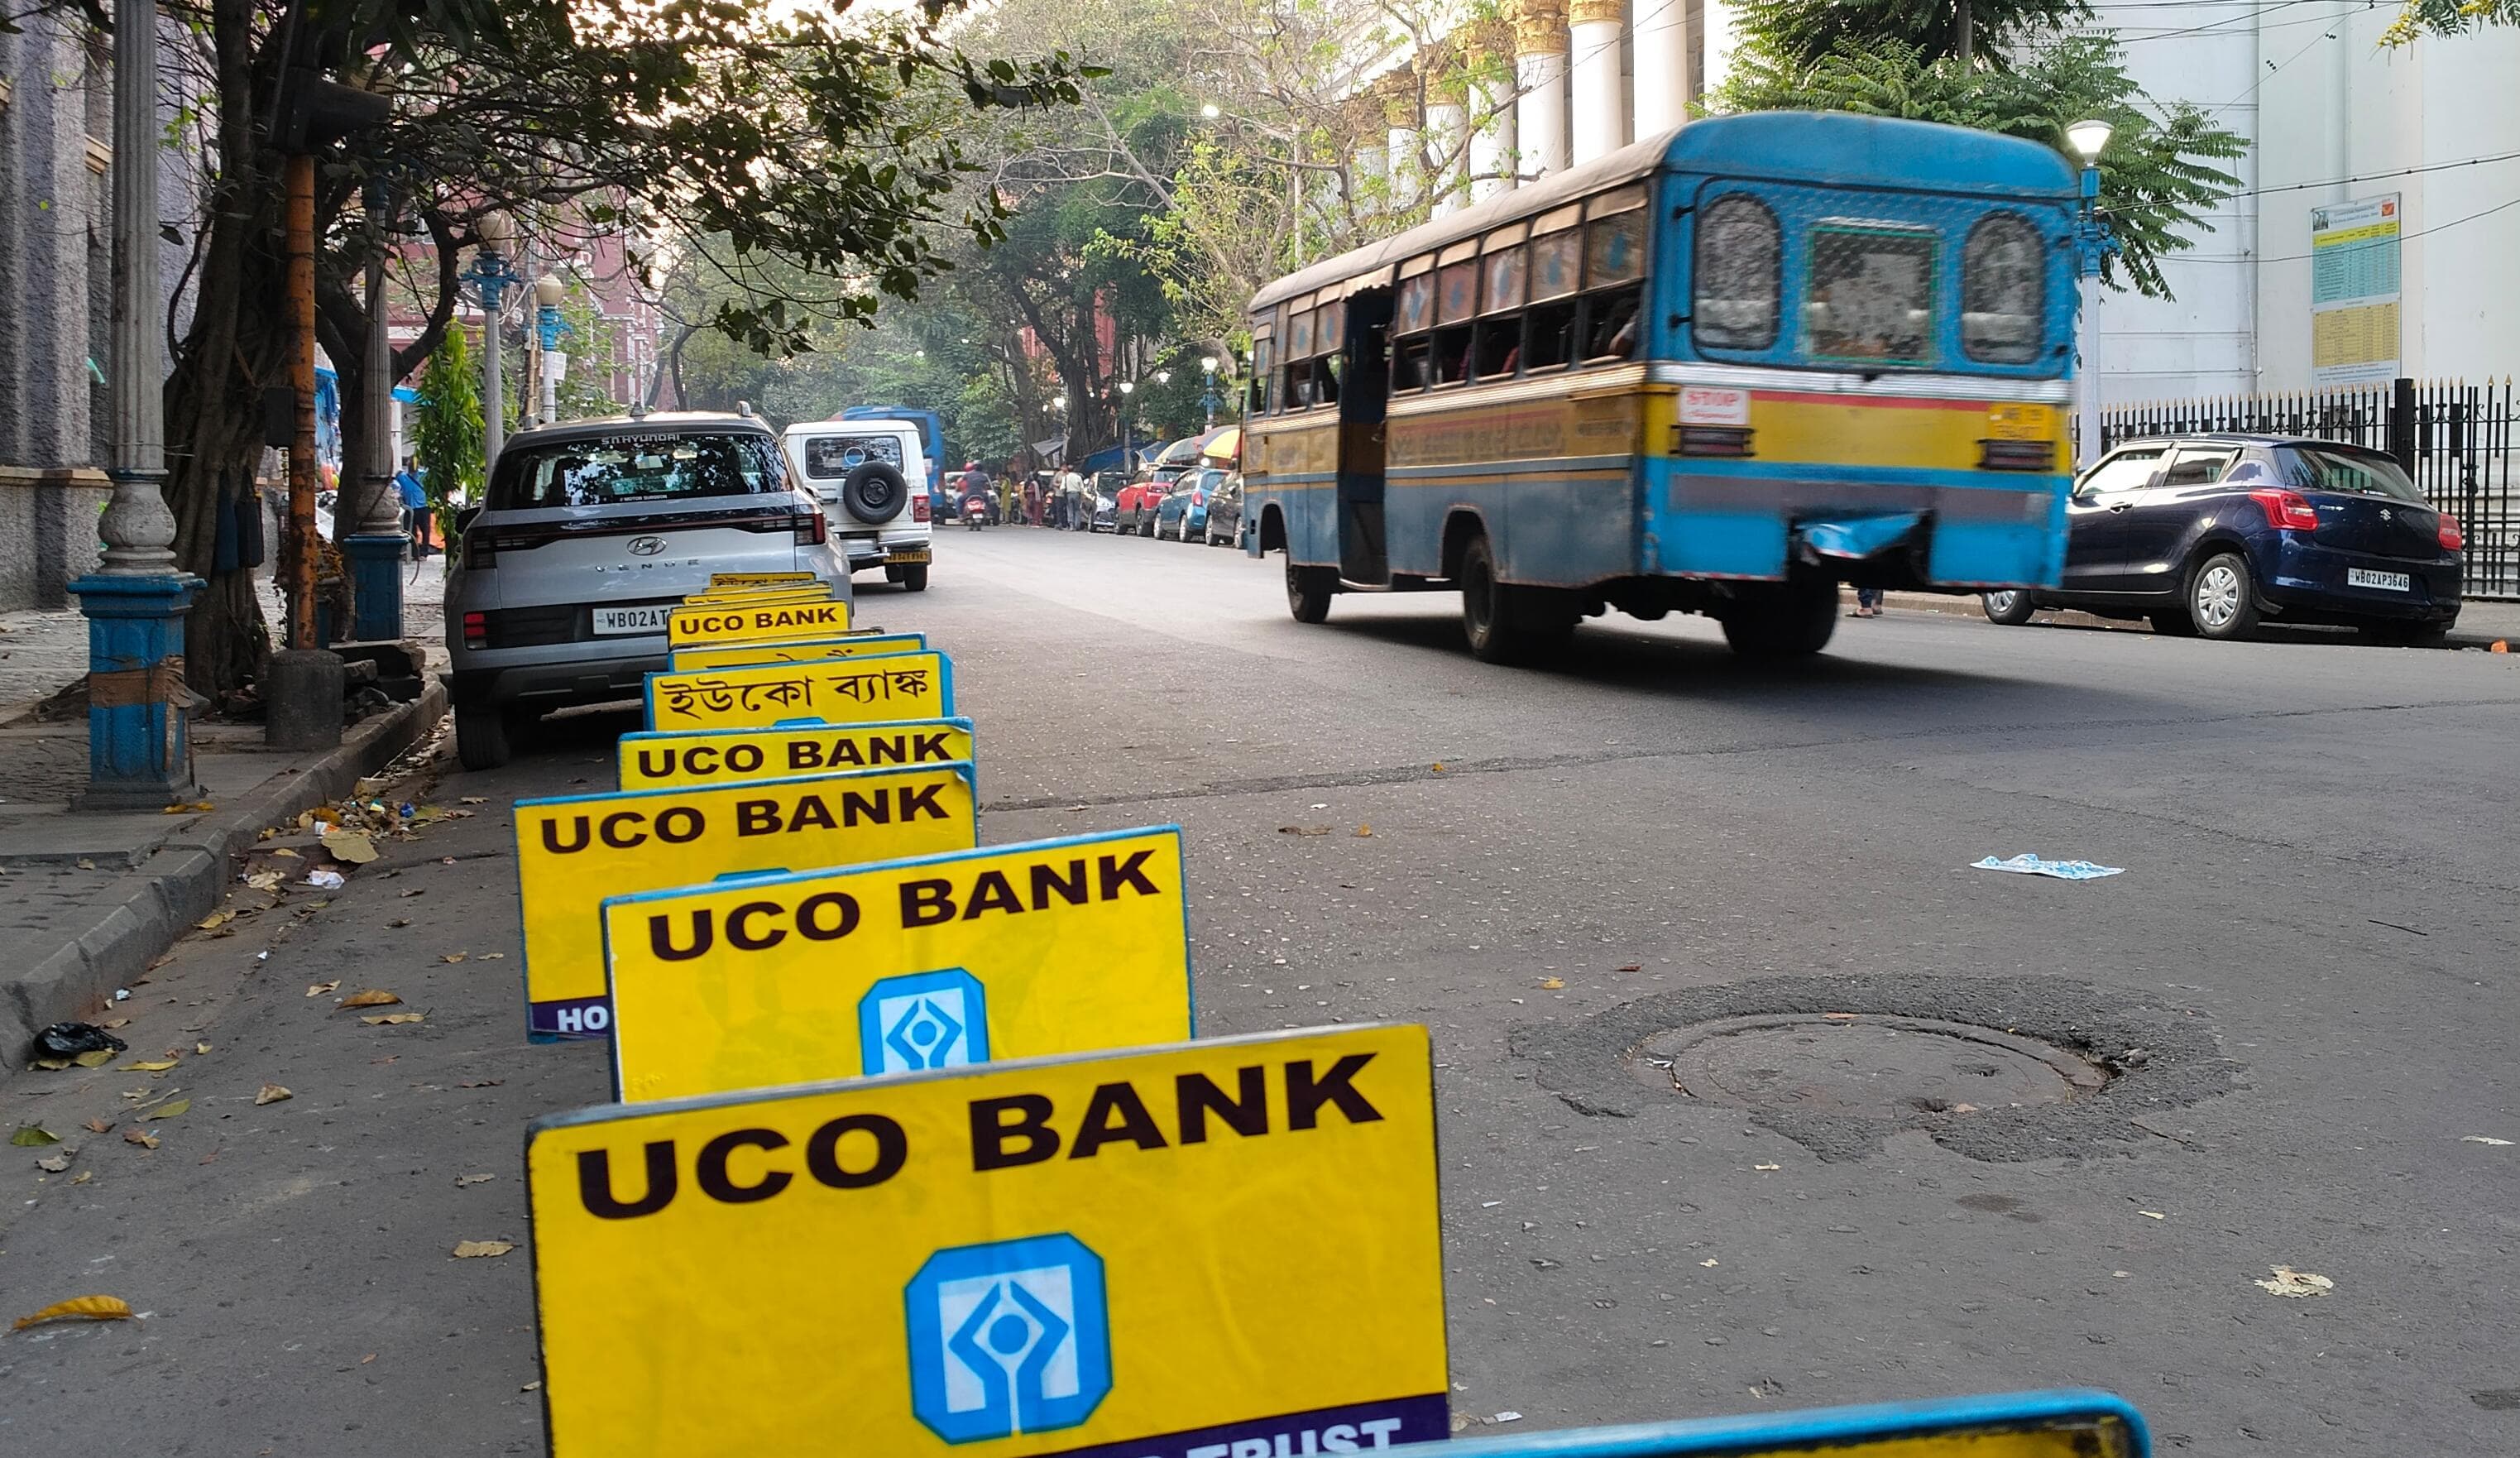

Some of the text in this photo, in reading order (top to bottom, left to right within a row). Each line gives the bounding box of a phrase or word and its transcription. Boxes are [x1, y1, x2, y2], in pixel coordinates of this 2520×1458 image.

[596, 559, 700, 573] VENUE
[2355, 571, 2409, 588] WB02AP3646
[680, 607, 837, 635] UCO BANK
[659, 676, 815, 720] ইউকো
[638, 732, 953, 778] UCO BANK
[541, 783, 950, 854] UCO BANK
[649, 849, 1160, 962] UCO BANK
[576, 1052, 1385, 1221] UCO BANK
